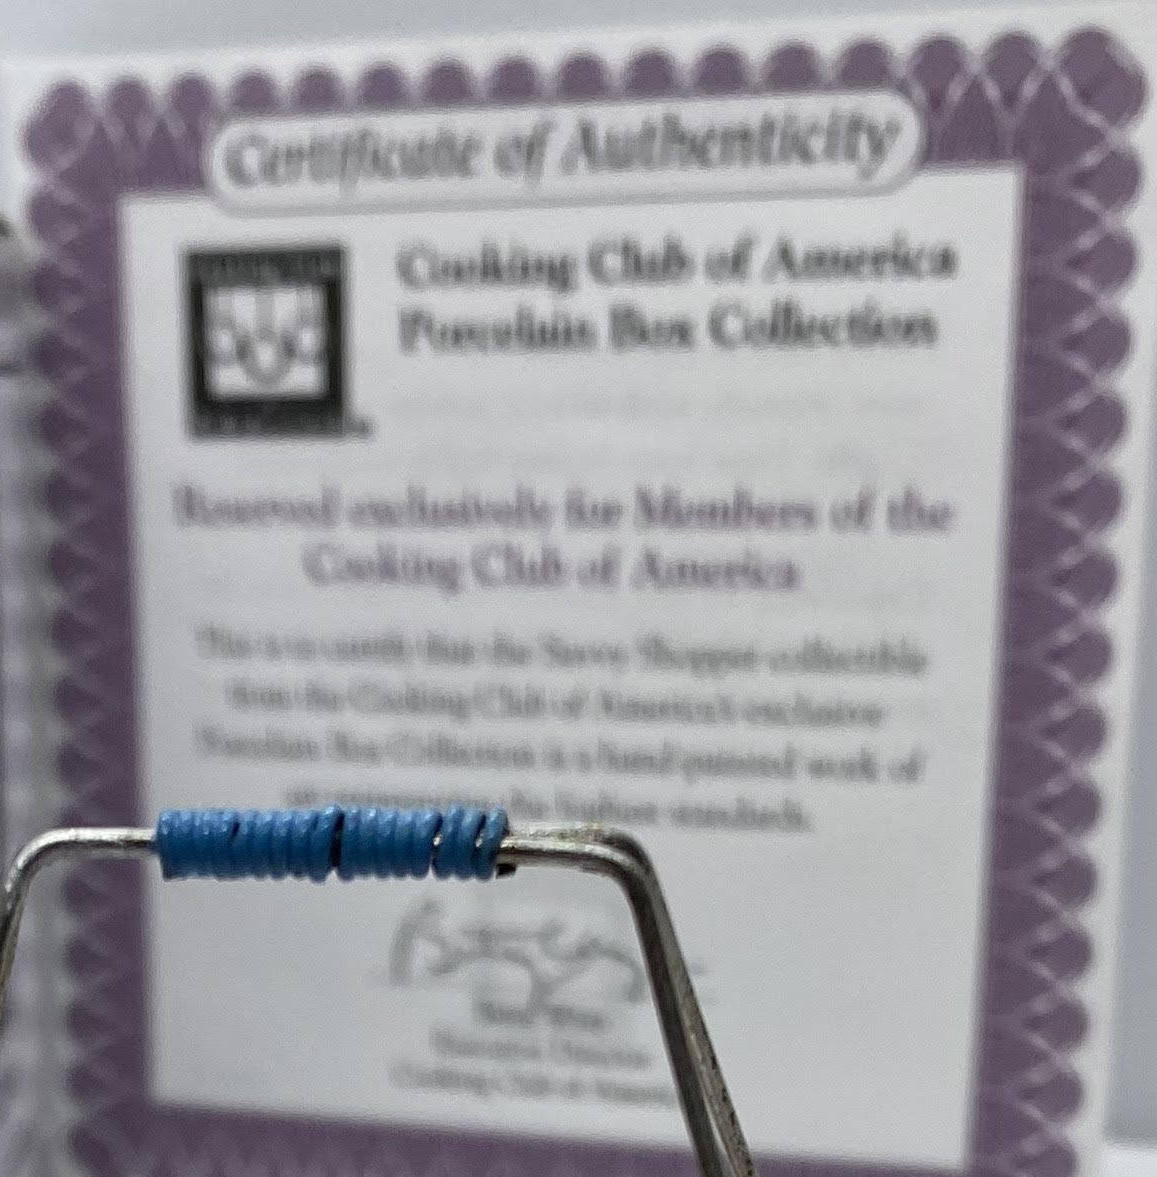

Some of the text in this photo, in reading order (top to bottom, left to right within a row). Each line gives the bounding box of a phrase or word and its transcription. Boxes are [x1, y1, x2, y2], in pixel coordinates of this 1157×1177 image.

[492, 116, 550, 188] of
[587, 234, 696, 284] Club
[704, 234, 756, 282] of
[762, 230, 958, 283] America
[608, 298, 697, 351] Box
[706, 297, 940, 349] Collection
[830, 484, 876, 534] of
[884, 486, 956, 534] the
